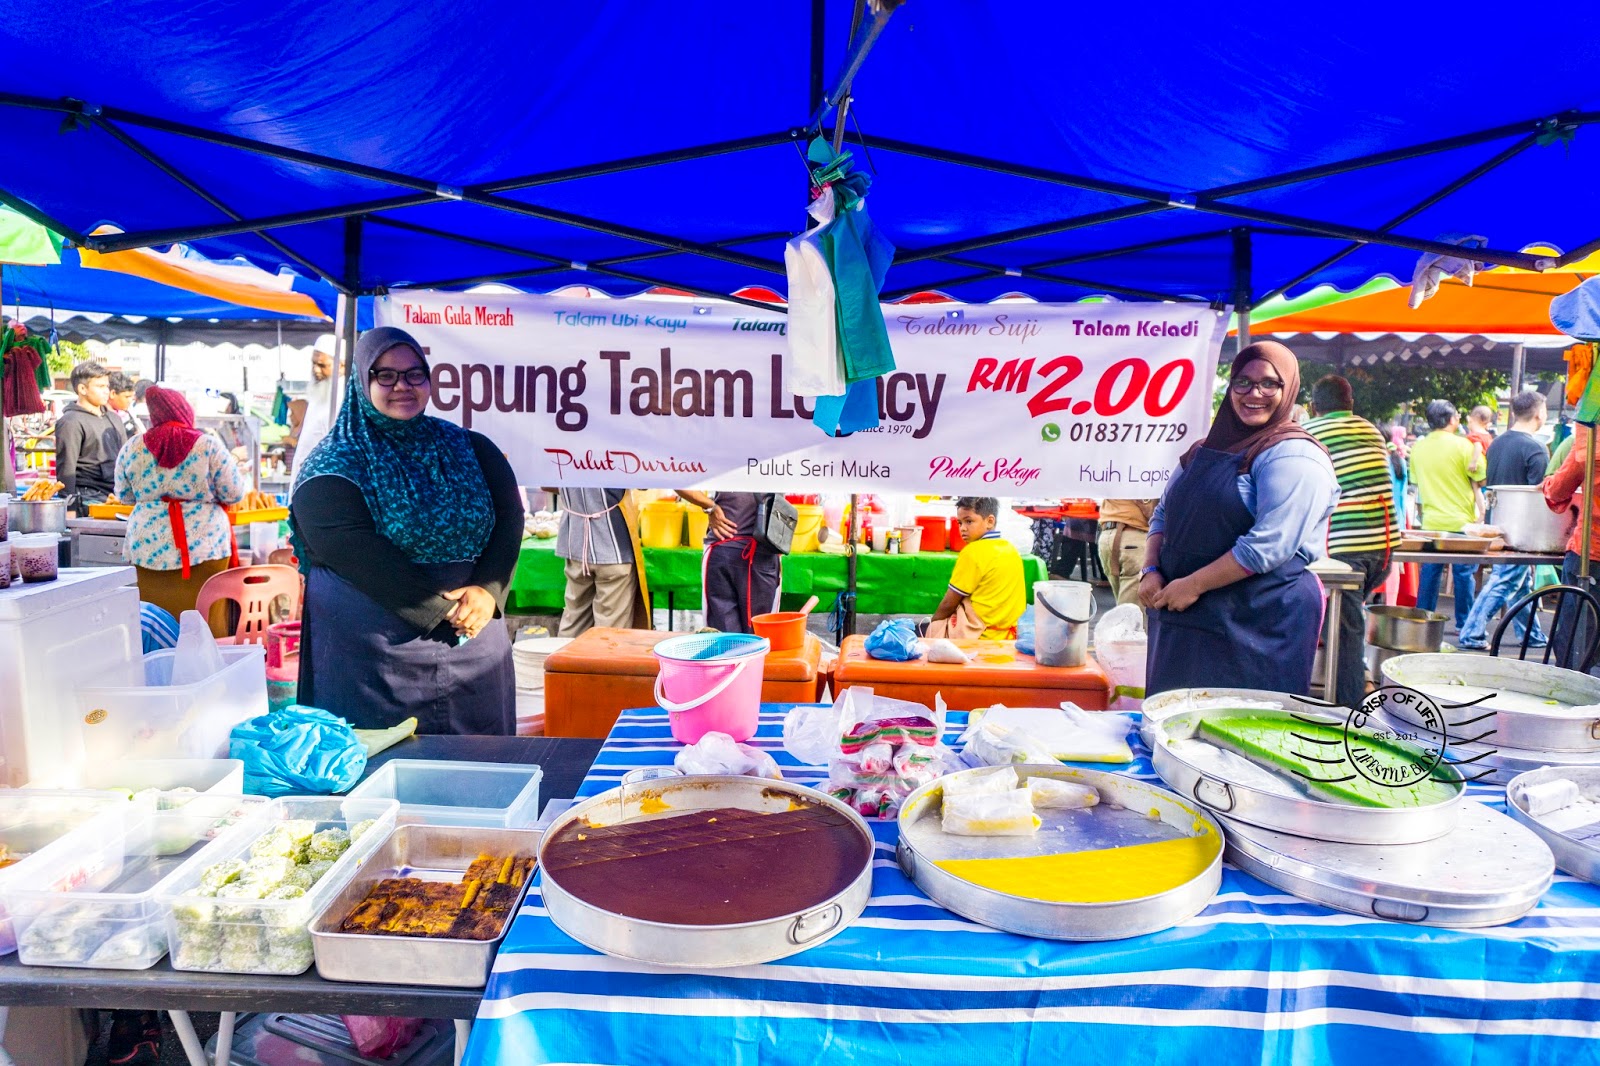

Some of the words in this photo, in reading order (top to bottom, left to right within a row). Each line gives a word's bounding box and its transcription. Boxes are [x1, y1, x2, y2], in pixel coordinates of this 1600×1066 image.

[403, 304, 441, 325] Talam
[444, 305, 471, 325] Gula
[474, 306, 514, 326] Merah
[553, 310, 606, 327] Talam
[612, 311, 639, 327] Ubi
[645, 315, 687, 333] Kayu
[732, 317, 786, 336] Talam
[897, 314, 981, 337] Talam
[988, 314, 1042, 344] Suji
[1072, 319, 1130, 337] Talam
[1136, 319, 1199, 337] Keladi
[421, 346, 589, 432] epung
[600, 347, 753, 418] Talam
[771, 354, 947, 439] Lcy
[887, 424, 913, 434] 1970
[1070, 422, 1188, 442] 0183717729
[544, 448, 615, 480] Pulut
[610, 451, 708, 474] Durian
[747, 457, 793, 476] Pulut
[800, 459, 834, 477] Seri
[841, 460, 891, 478] Muka
[929, 456, 986, 480] Pulut
[1080, 460, 1121, 482] Kuih
[1128, 465, 1170, 487] Lapis
